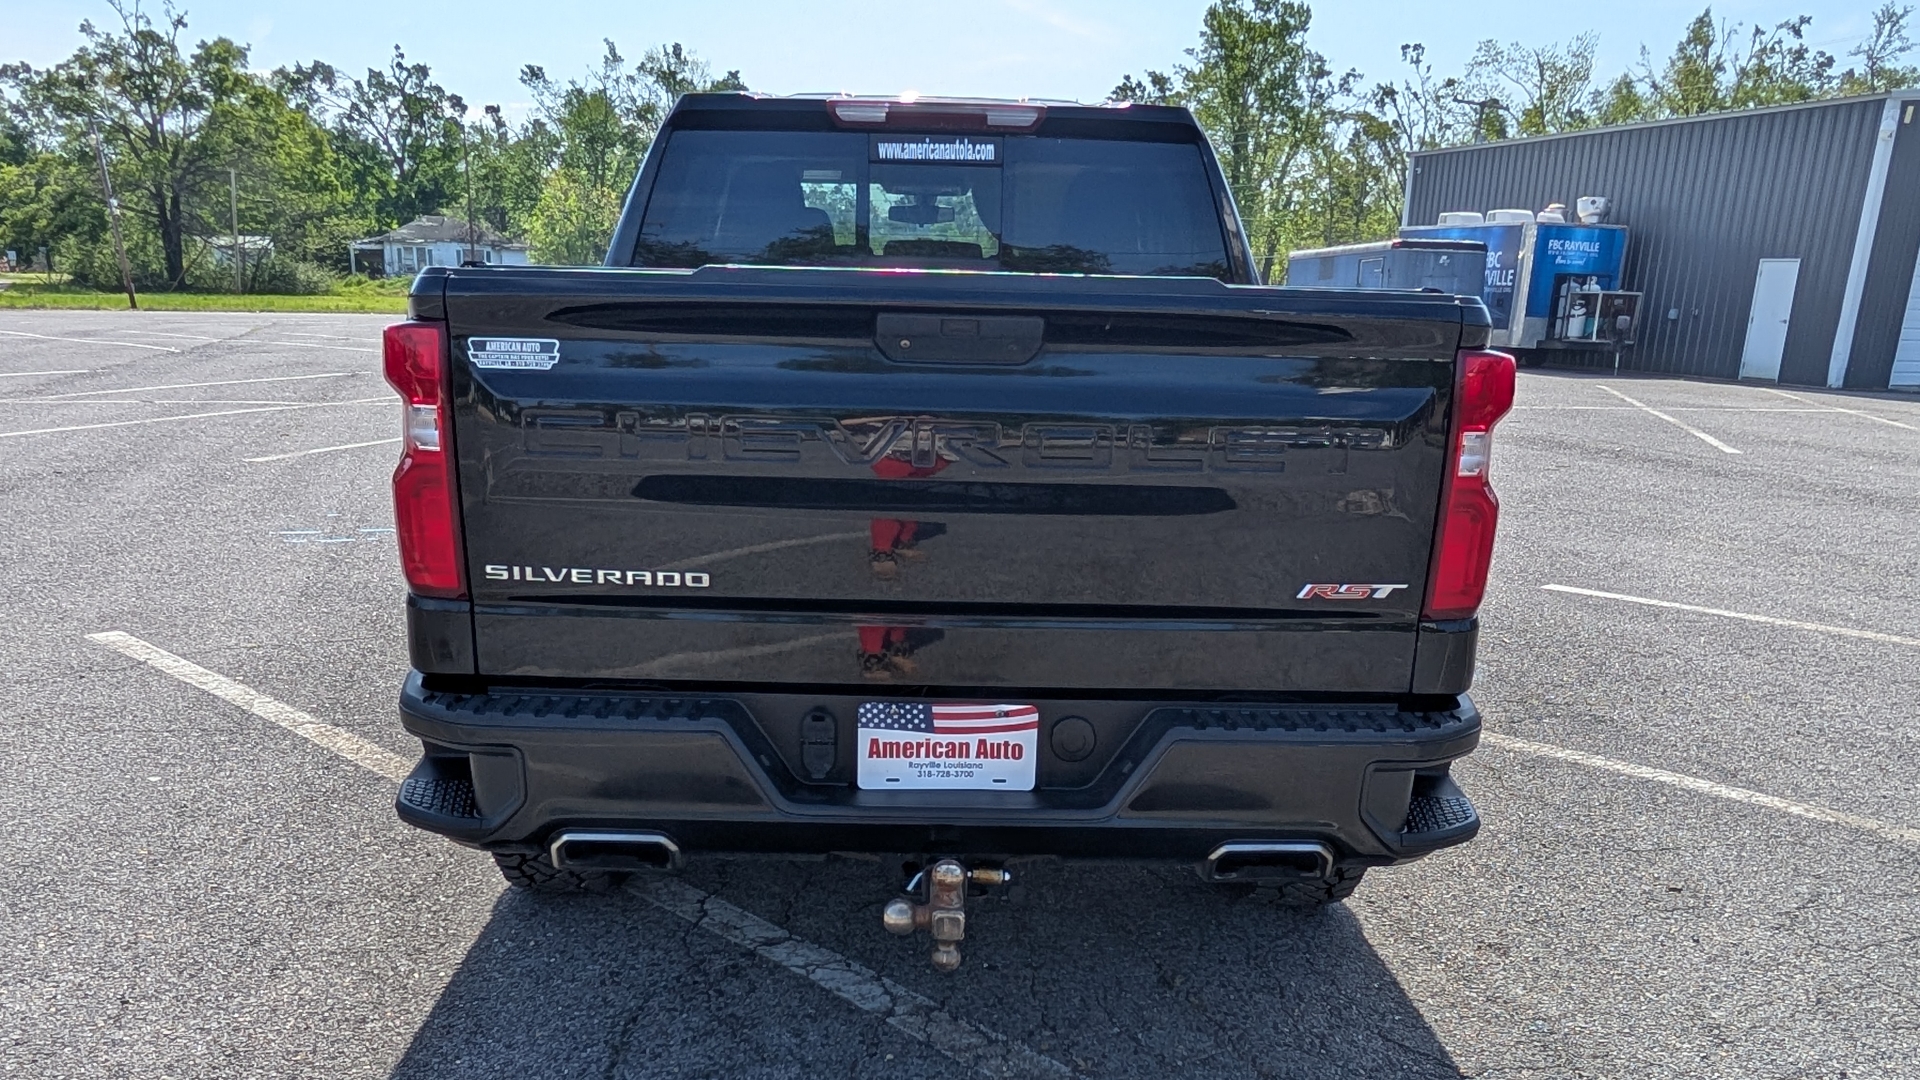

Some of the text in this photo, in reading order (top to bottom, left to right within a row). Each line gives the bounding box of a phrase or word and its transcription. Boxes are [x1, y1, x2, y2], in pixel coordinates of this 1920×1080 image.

[878, 138, 995, 160] www.americanautola.com
[1548, 239, 1600, 252] FBC RAYVILLE
[485, 341, 541, 352] AMERICAN AUTO
[522, 409, 1385, 475] CHEVROLET
[485, 565, 710, 588] SILVERADO
[1296, 584, 1409, 599] RST
[868, 738, 1024, 760] American Auto
[908, 761, 983, 770] Rayville Louisiana
[917, 770, 974, 778] 318-728-3700
